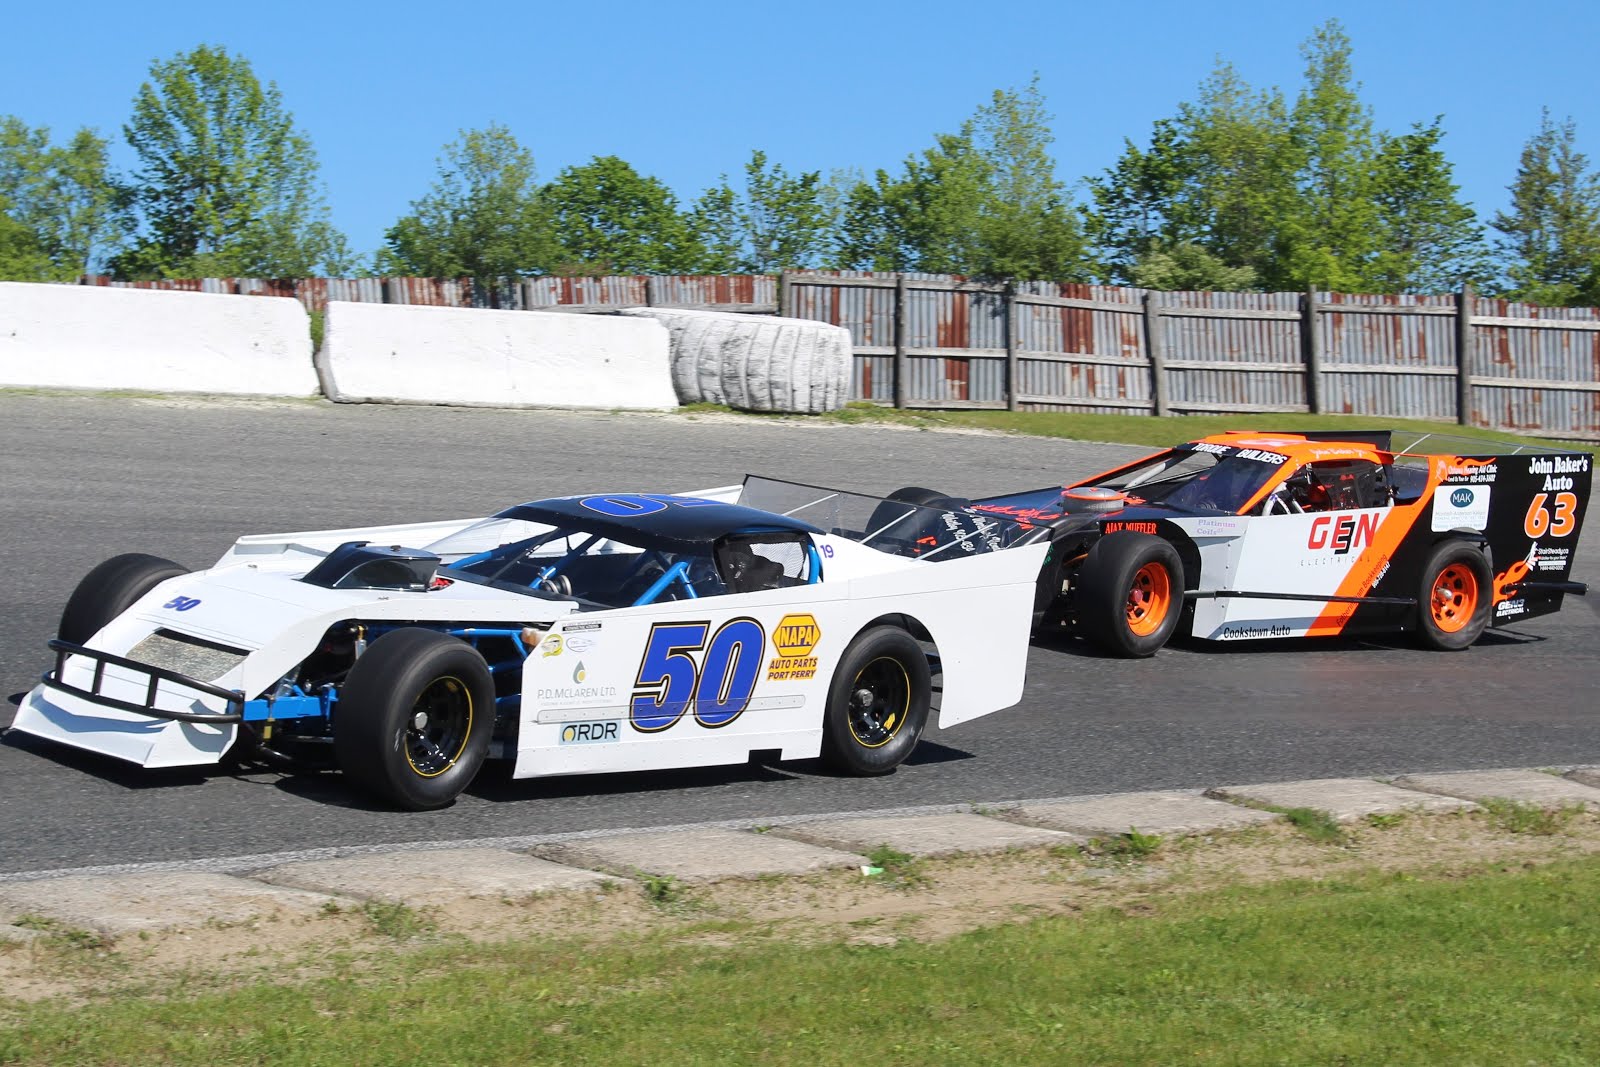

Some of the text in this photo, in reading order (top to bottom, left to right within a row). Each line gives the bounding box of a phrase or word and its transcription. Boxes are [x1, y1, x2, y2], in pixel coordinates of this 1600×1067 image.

[1191, 443, 1287, 464] TORQUE BUILDERS
[1529, 456, 1588, 474] John Baker's
[1542, 475, 1574, 491] Auto
[1452, 493, 1472, 503] MAK
[1524, 492, 1577, 538] 63
[1126, 523, 1156, 534] MUFFLER
[1198, 519, 1235, 528] Platinum
[820, 544, 834, 558] 19
[1336, 554, 1388, 627] Fotheringam Bookkeeping
[163, 596, 202, 611] 50
[780, 626, 814, 646] NAPA
[1224, 625, 1291, 638] Cookstown Auto
[769, 658, 818, 669] AUTO PARTS
[630, 616, 766, 733] 50
[768, 669, 816, 679] PORT PERRY
